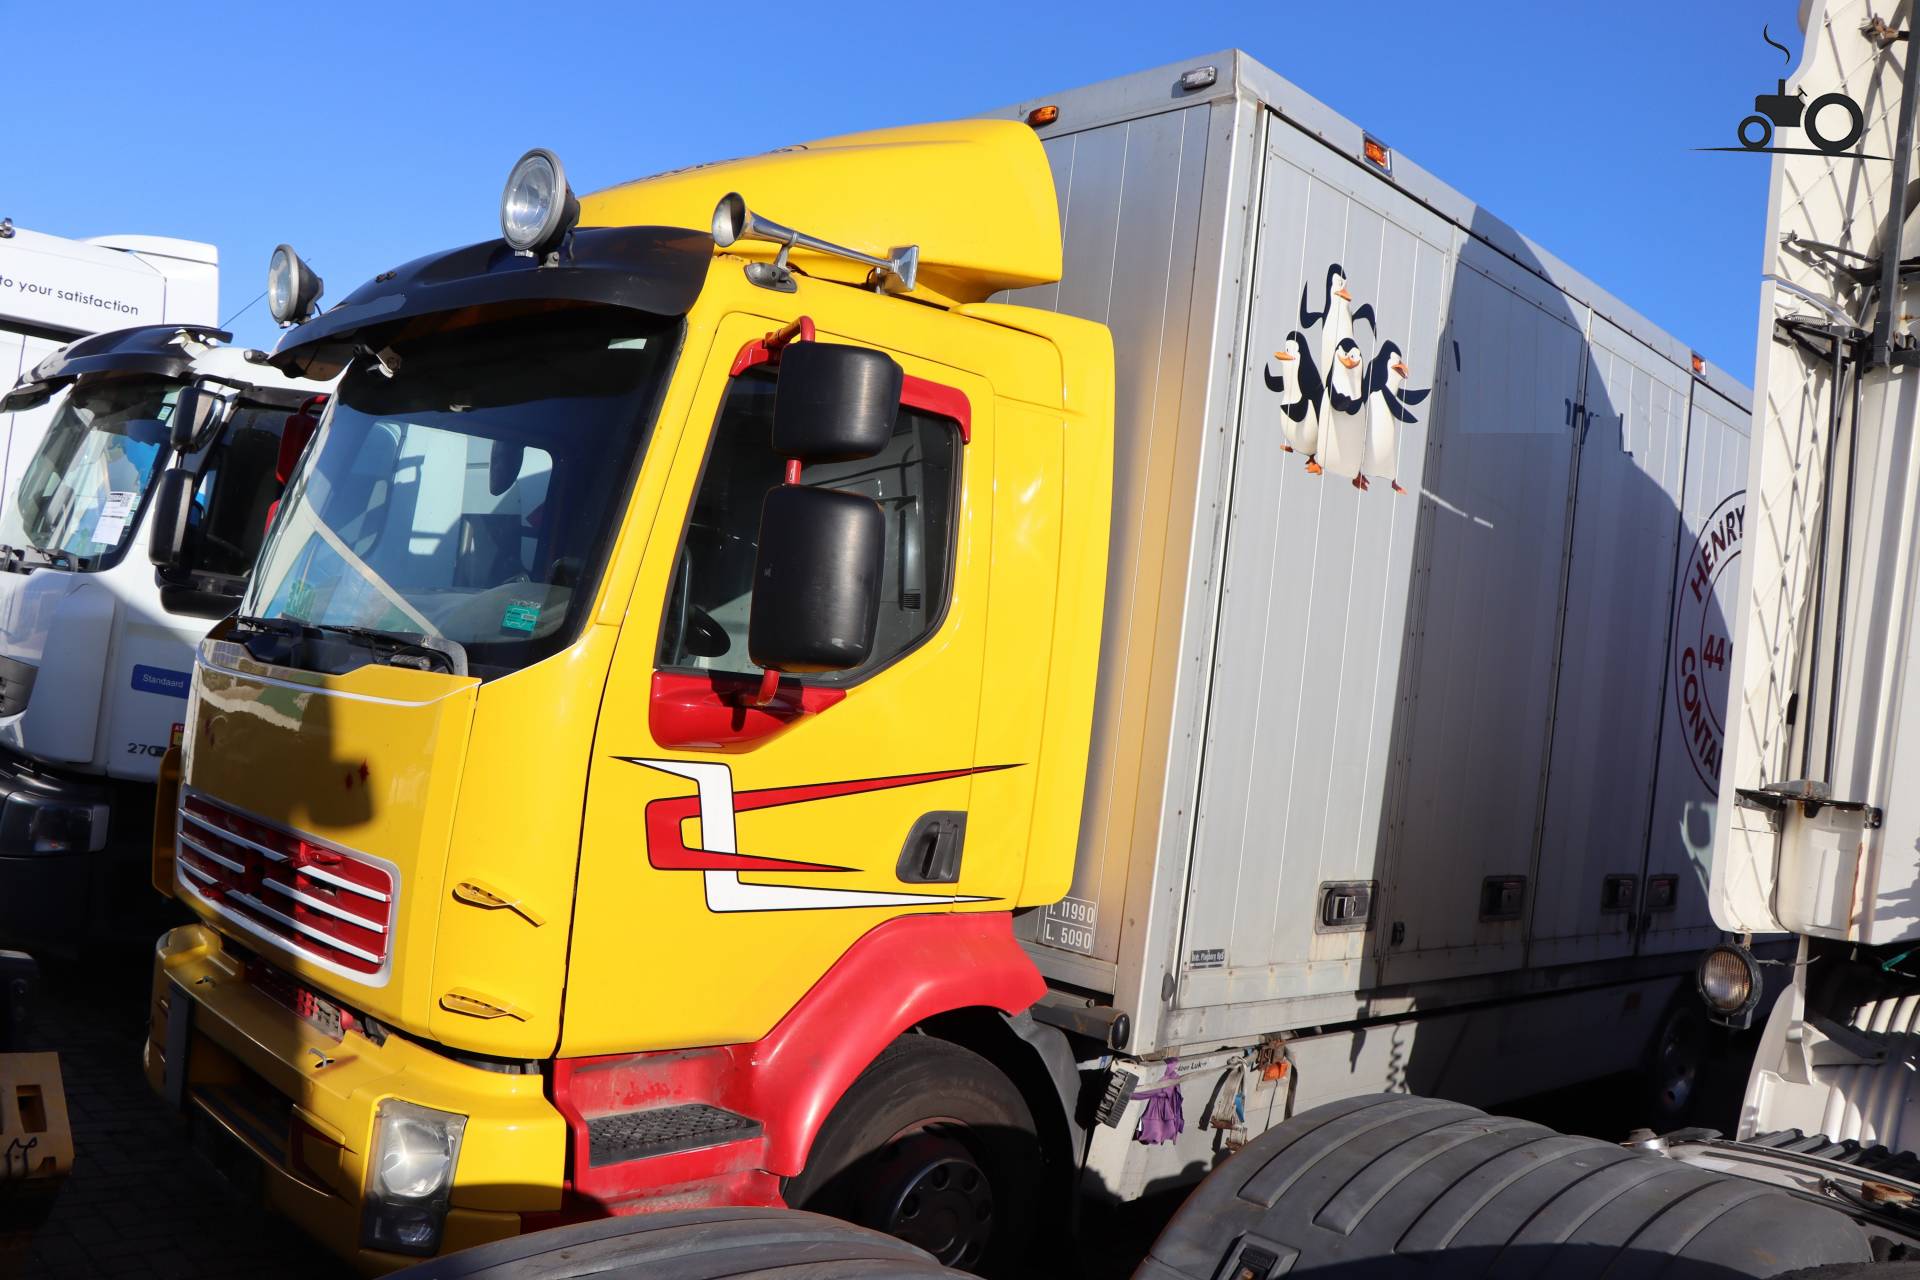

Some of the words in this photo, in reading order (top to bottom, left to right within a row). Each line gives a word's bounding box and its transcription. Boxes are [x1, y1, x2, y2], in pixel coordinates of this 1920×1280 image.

[19, 281, 52, 296] your
[57, 289, 139, 316] satisfaction
[1690, 505, 1745, 603] HENRY
[1703, 634, 1725, 671] 44
[142, 673, 184, 688] Standaard
[1681, 647, 1723, 780] CONTAI
[1062, 901, 1094, 923] 11990
[1046, 923, 1055, 941] L.
[1060, 927, 1091, 949] 5090
